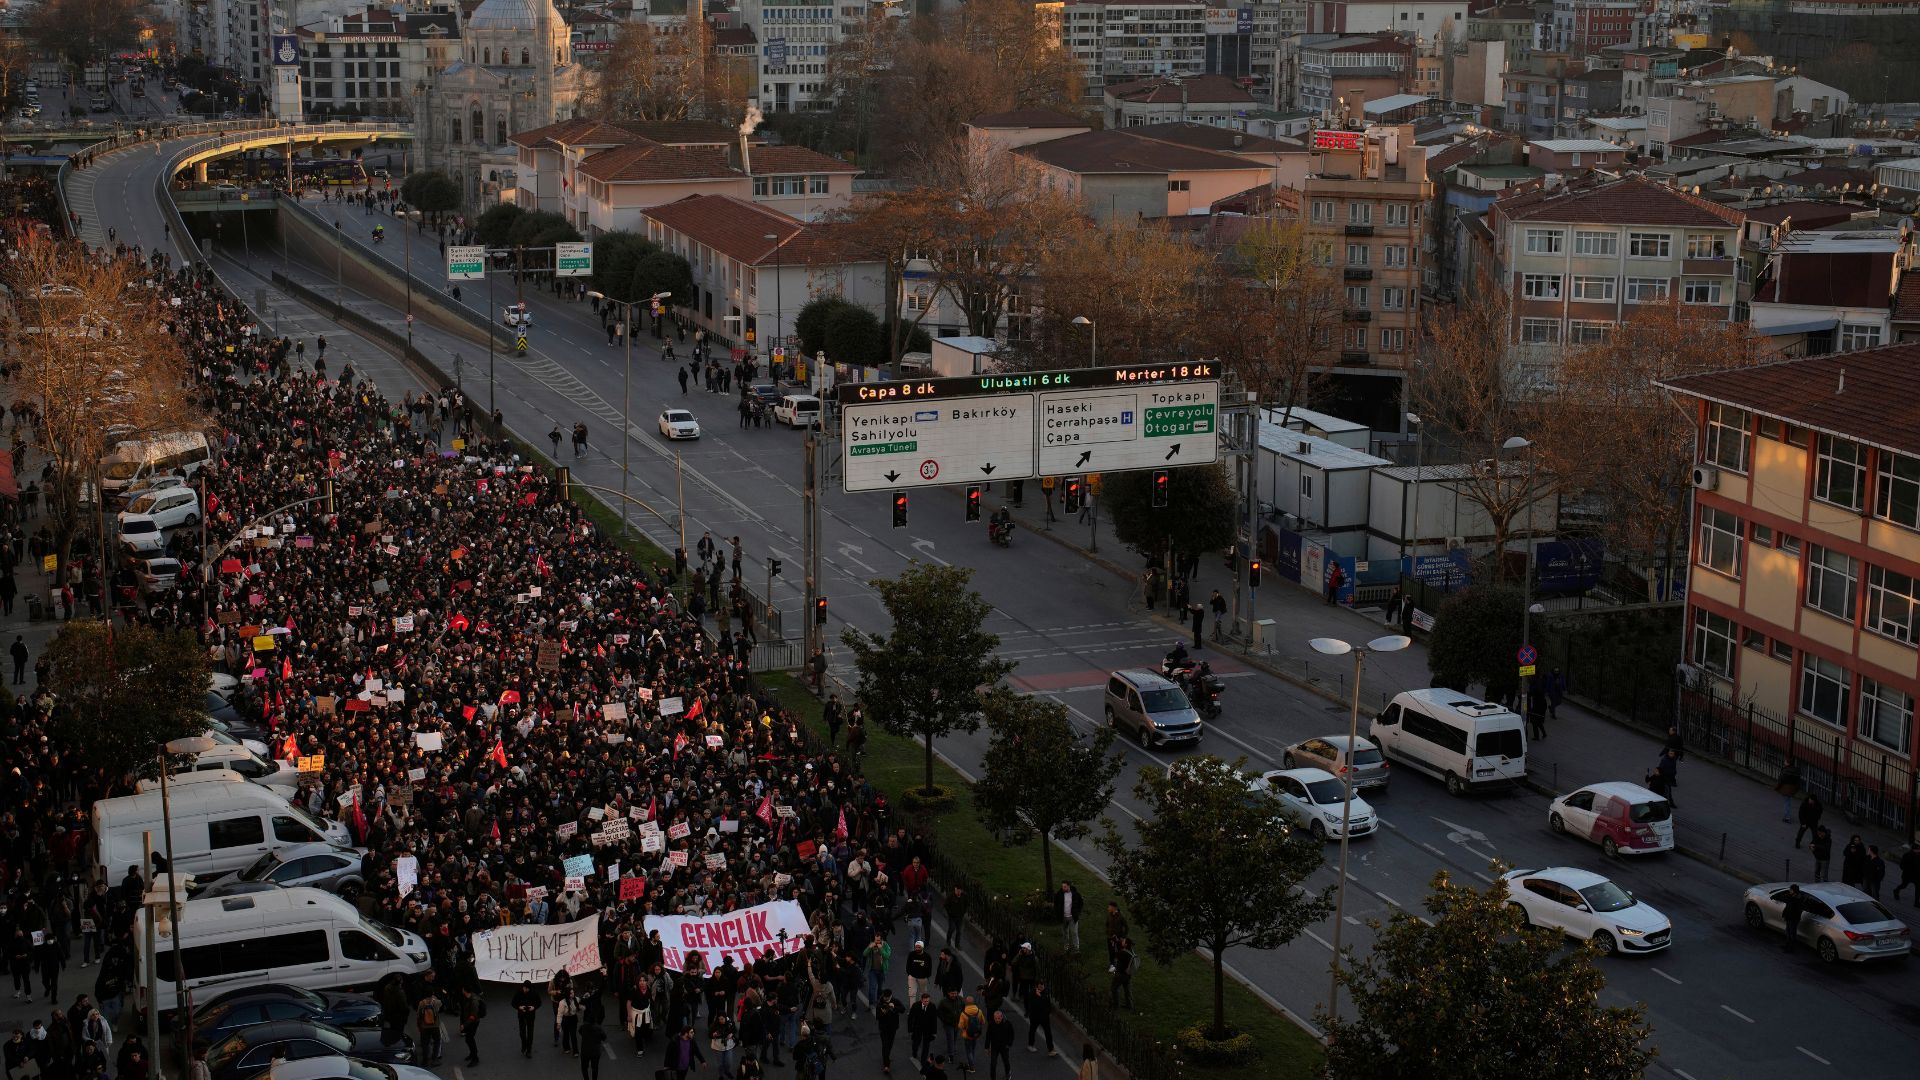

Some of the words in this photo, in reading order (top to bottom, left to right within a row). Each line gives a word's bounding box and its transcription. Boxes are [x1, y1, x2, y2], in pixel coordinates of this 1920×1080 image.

[1316, 137, 1359, 149] HOTEL
[1116, 368, 1164, 382] Merter
[1171, 366, 1188, 377] 18
[1194, 365, 1210, 376] dk
[981, 375, 1037, 390] Ulubatlı
[1042, 375, 1049, 385] 6
[1054, 373, 1071, 384] dk
[859, 386, 895, 400] Çapa
[902, 385, 911, 396] 8
[916, 382, 935, 394] dk
[1152, 392, 1205, 404] Topkapı
[952, 406, 1017, 420] Bakırköy
[1047, 403, 1093, 414] Haseki
[1145, 406, 1214, 421] Çevreyolu
[852, 414, 913, 427] Yenikapı
[1047, 415, 1118, 429] Cerrahpaşa
[1145, 421, 1191, 433] Otogar
[852, 426, 917, 441] Sahilyolu
[1047, 432, 1080, 445] Çapa
[851, 445, 887, 456] Avrasya
[889, 442, 916, 453] Tüneli
[680, 910, 773, 949] GENÇLİK
[487, 929, 584, 962] HÜKÜMET
[663, 946, 712, 976] BİT
